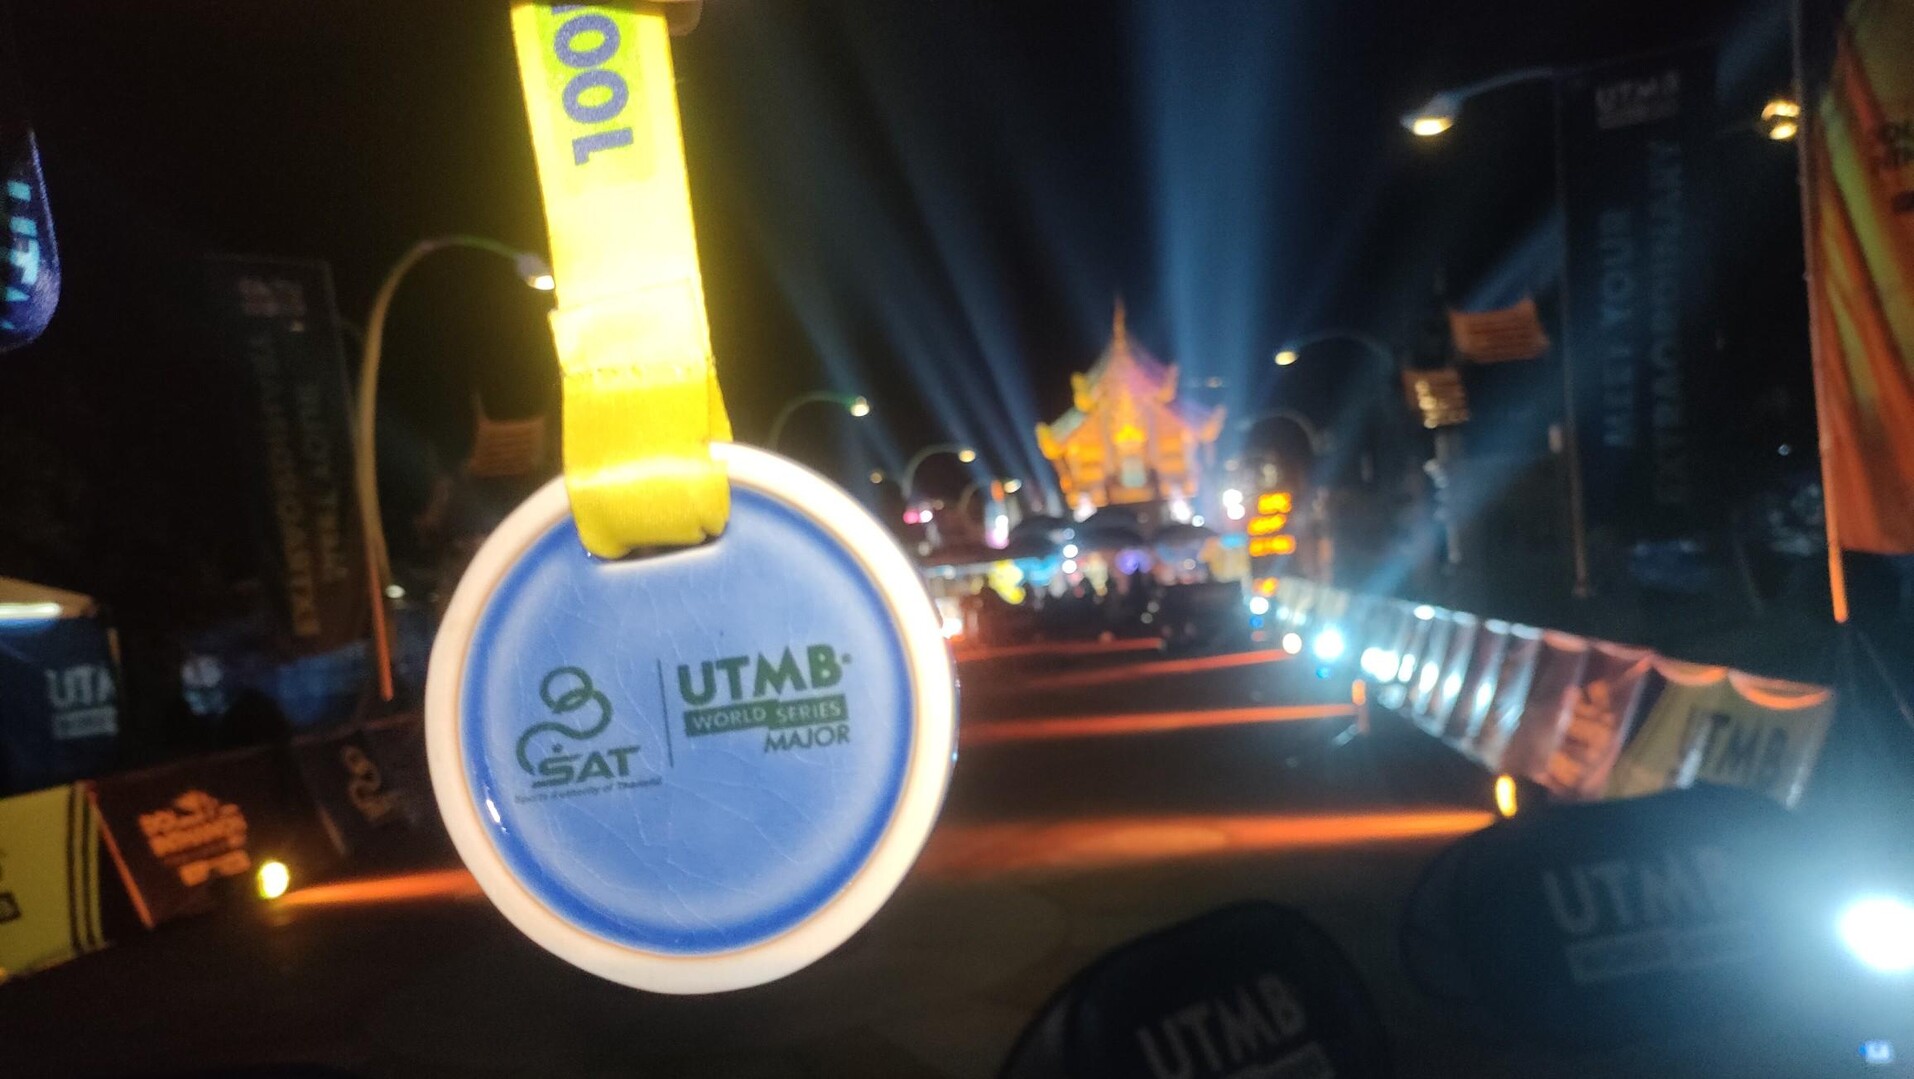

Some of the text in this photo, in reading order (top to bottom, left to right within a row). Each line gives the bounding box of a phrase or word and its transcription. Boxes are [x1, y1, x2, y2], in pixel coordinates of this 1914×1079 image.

[551, 4, 634, 166] 100
[677, 644, 843, 706] UTMB
[691, 701, 842, 732] WORLD SERIES
[764, 725, 851, 753] MAJOR
[531, 745, 641, 789] SAT
[1135, 972, 1307, 1079] UTMB
